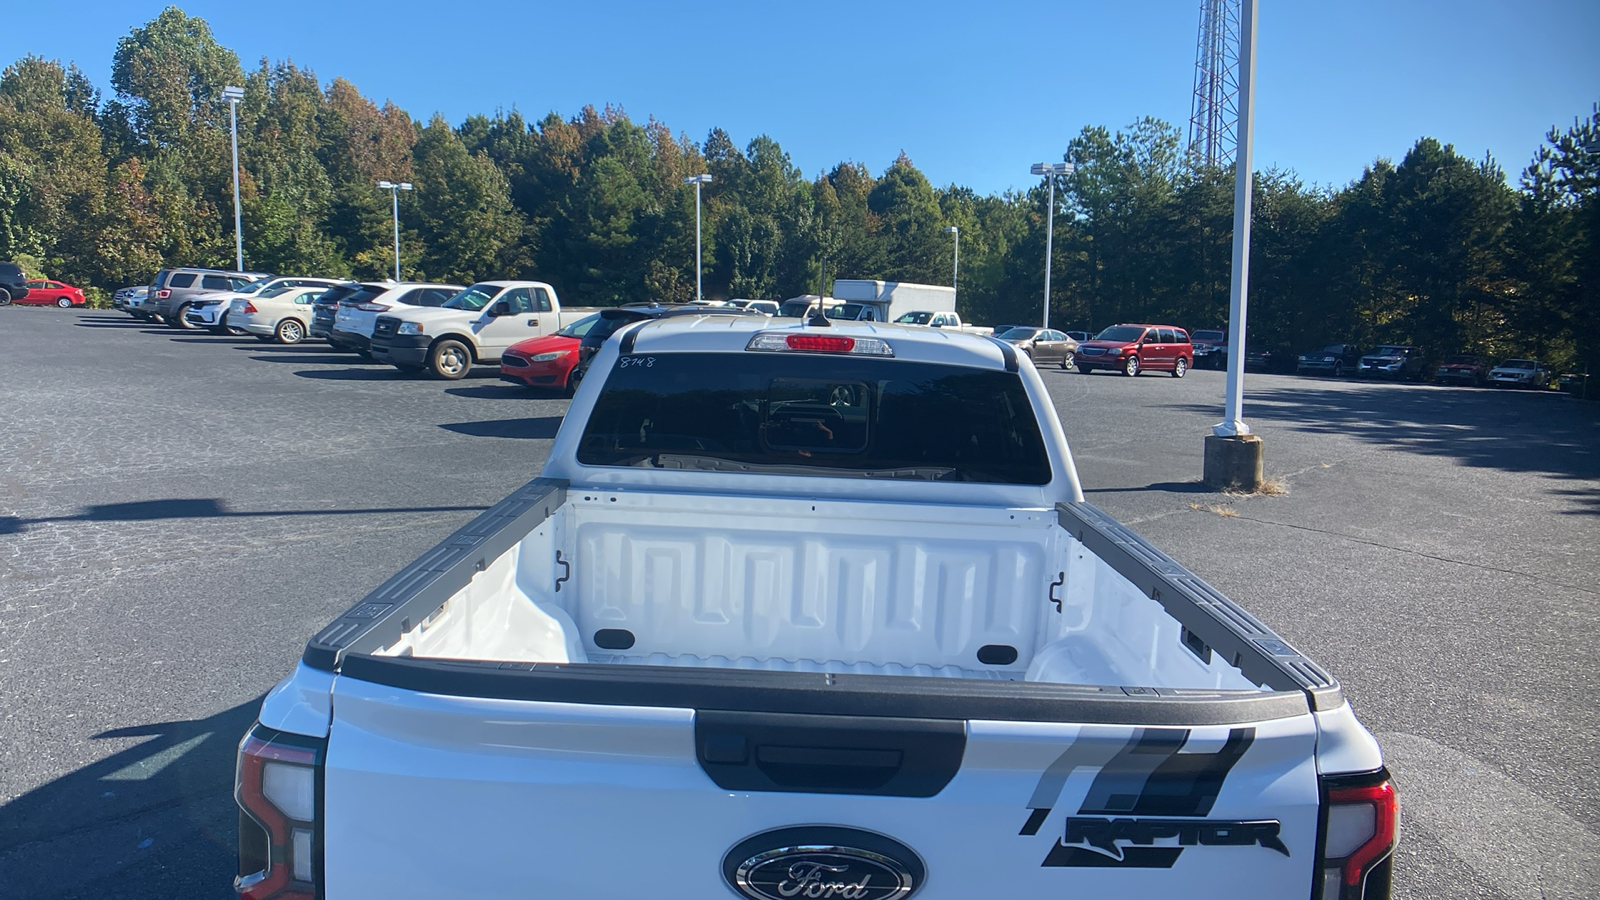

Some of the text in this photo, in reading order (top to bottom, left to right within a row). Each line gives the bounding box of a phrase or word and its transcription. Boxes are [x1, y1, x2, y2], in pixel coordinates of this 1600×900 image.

[620, 356, 657, 368] 8748
[1065, 816, 1291, 858] RAPTOR
[777, 861, 872, 899] Ford
